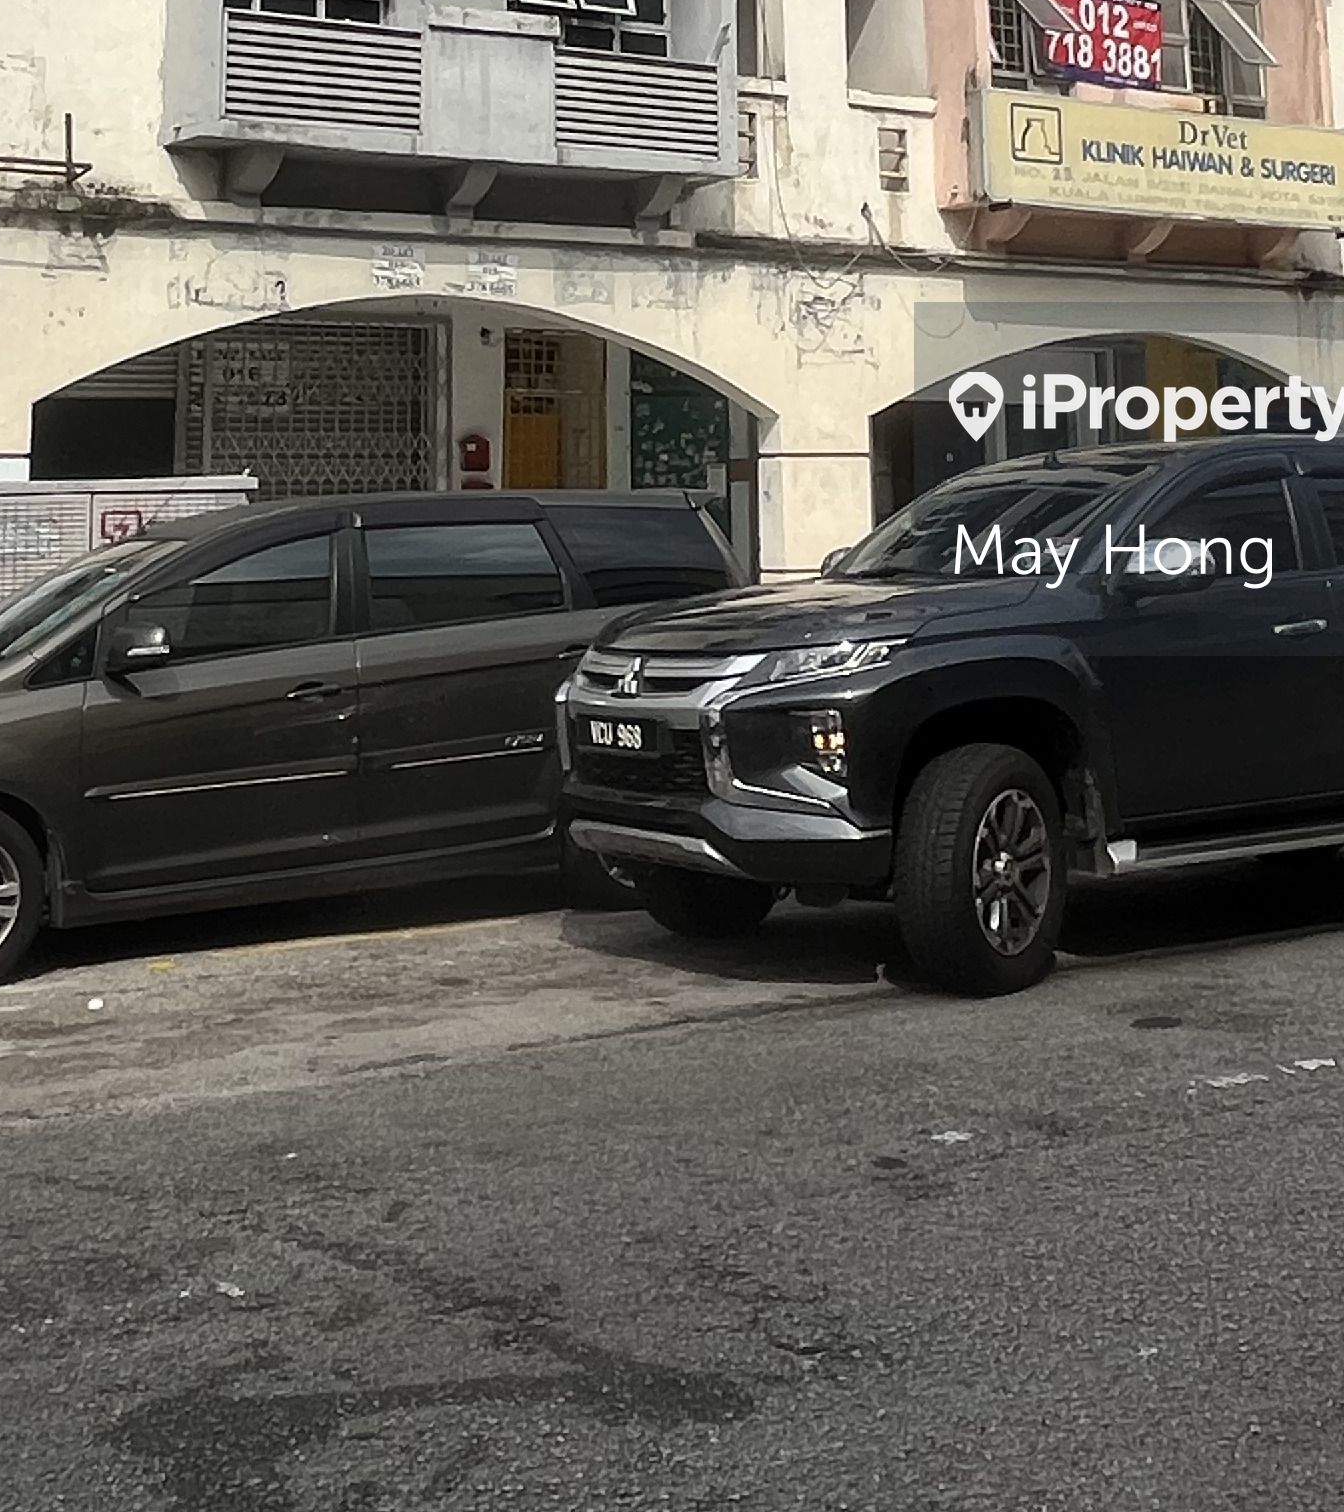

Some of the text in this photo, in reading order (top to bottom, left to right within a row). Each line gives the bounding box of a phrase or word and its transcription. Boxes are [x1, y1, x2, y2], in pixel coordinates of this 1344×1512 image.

[1044, 29, 1094, 68] 718
[1081, 138, 1336, 185] KLINIK HAIWAN & SURGERI
